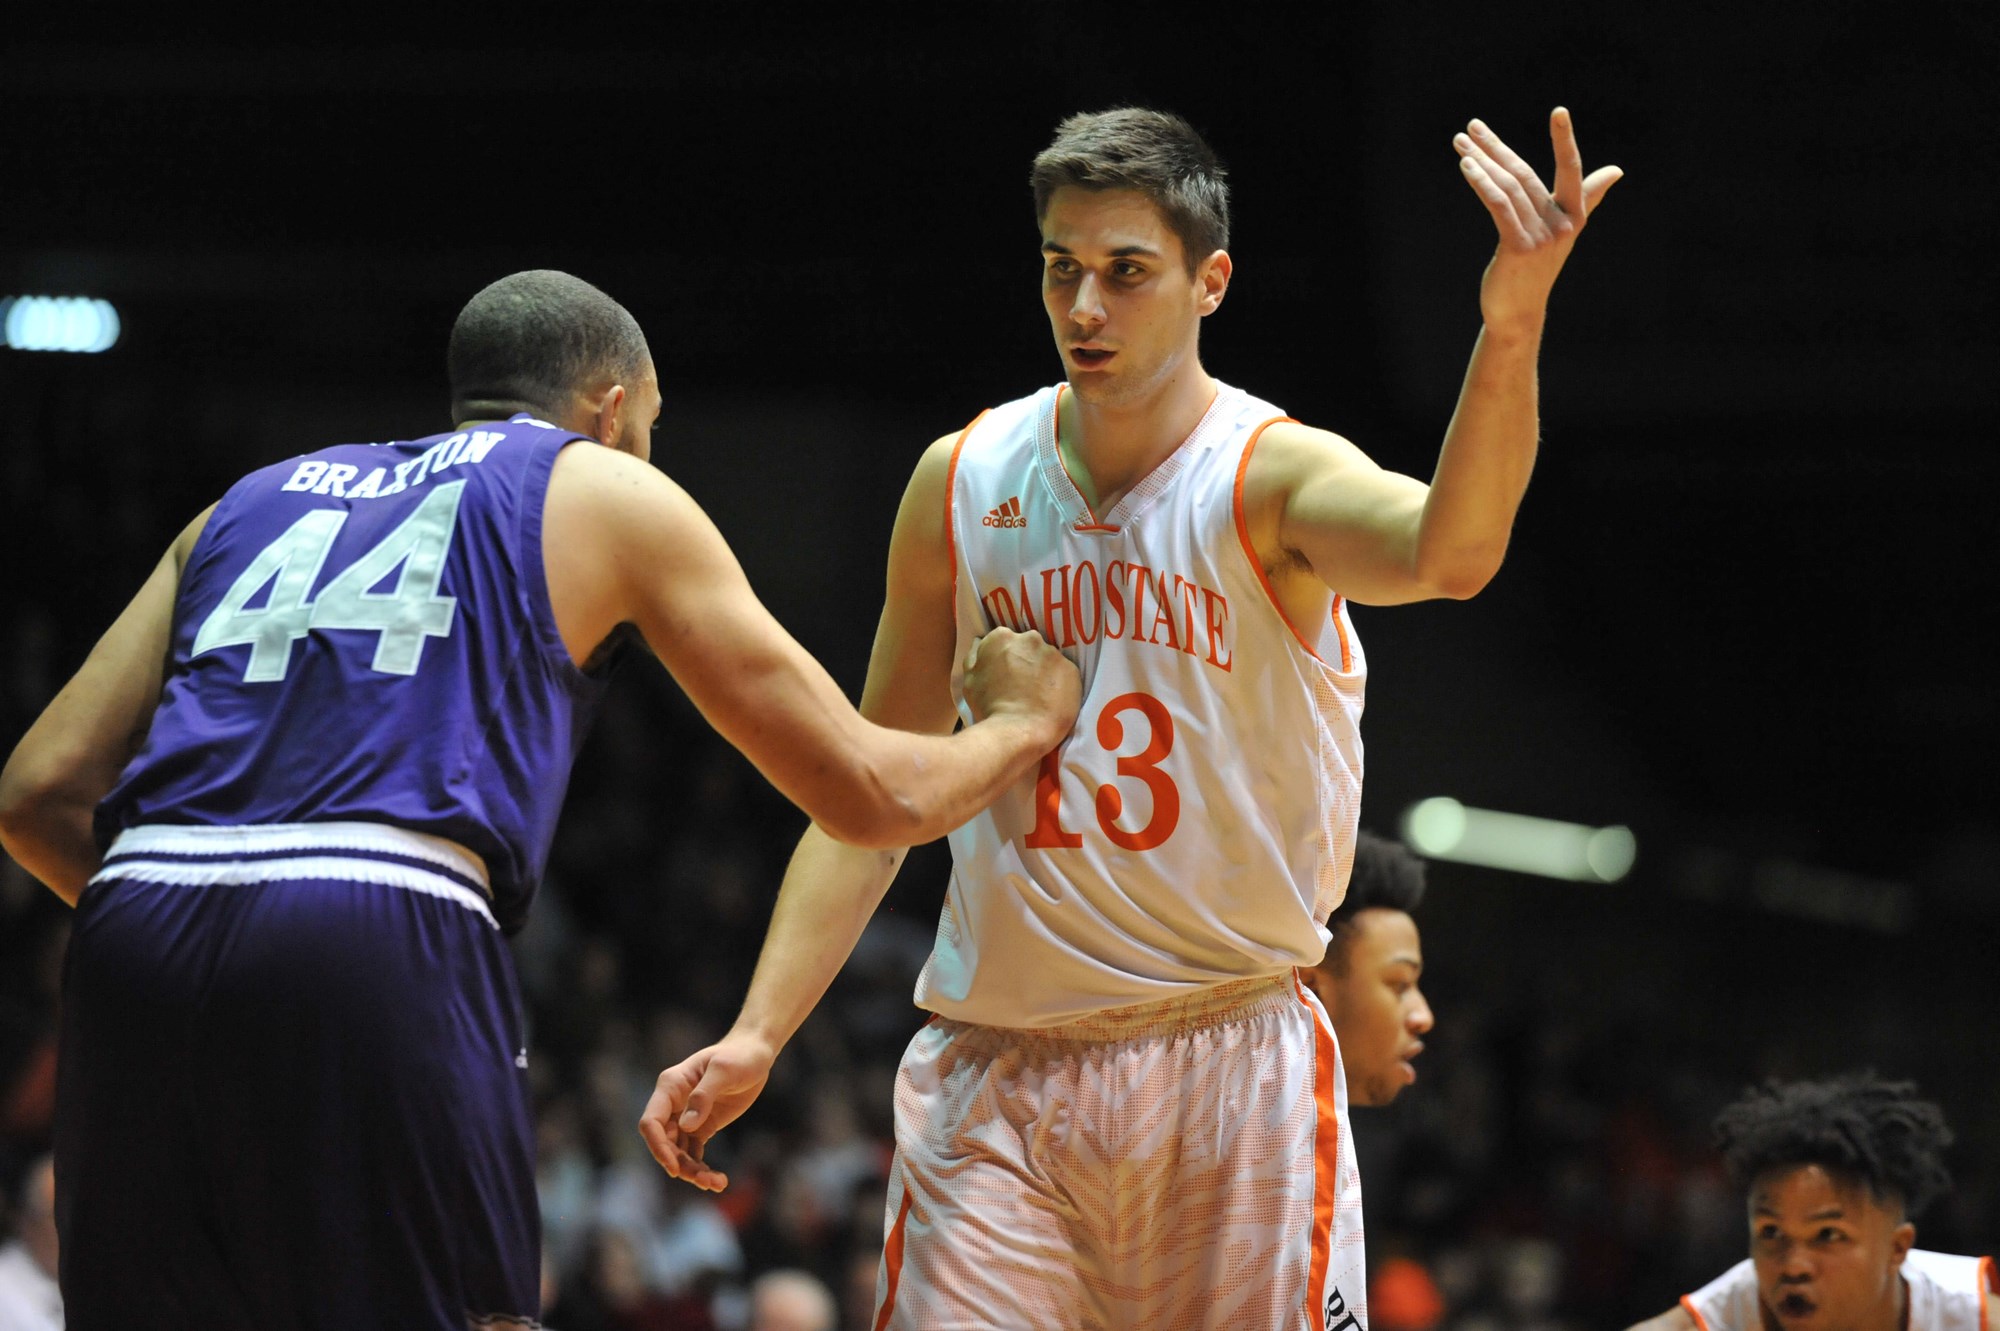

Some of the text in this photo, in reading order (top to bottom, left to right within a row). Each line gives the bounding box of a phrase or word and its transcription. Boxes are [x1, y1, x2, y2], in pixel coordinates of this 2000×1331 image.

[281, 431, 506, 499] BRAXTON
[982, 516, 1027, 528] adidas
[191, 479, 467, 683] 44
[1104, 560, 1232, 673] STATE
